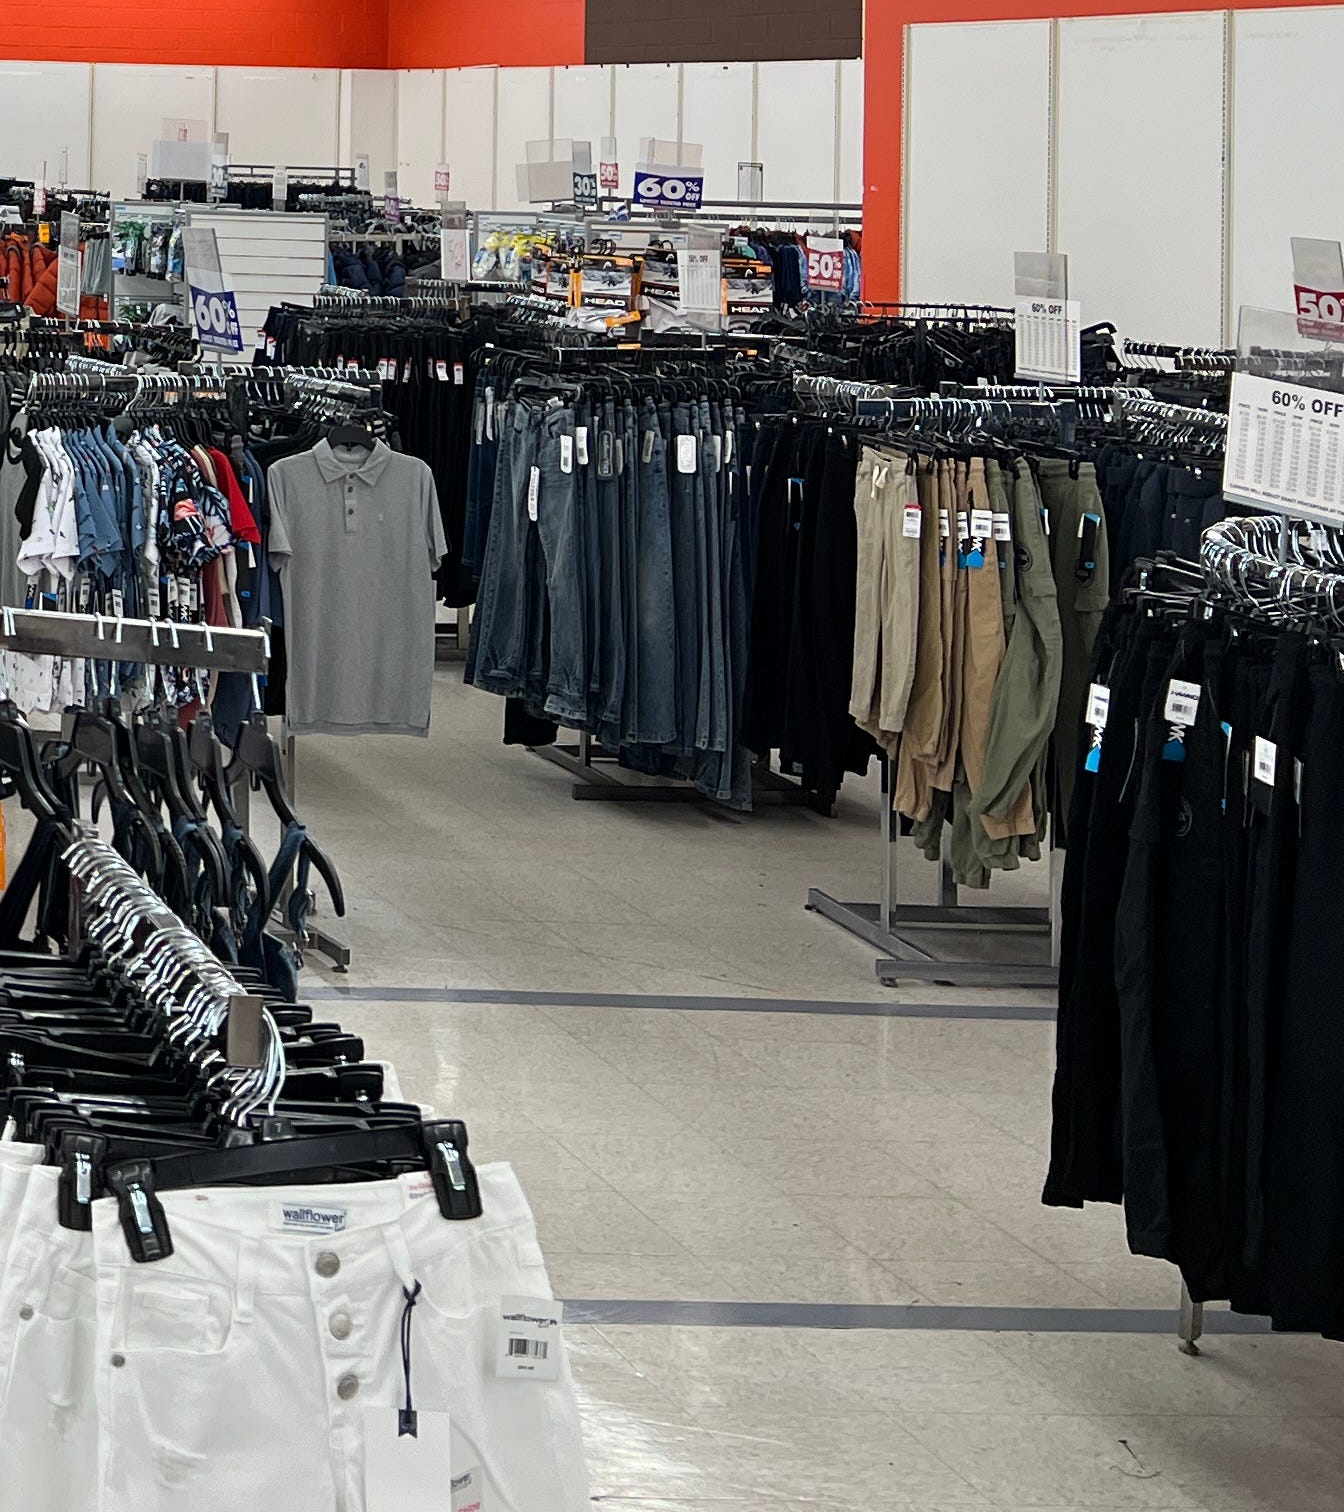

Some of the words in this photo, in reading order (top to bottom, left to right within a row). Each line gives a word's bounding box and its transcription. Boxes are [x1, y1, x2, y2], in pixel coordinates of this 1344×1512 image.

[637, 177, 700, 200] 60%
[685, 192, 700, 201] OFF
[808, 252, 842, 279] 50%
[584, 297, 626, 307] HEAD
[644, 287, 681, 297] HEA
[195, 294, 236, 334] 60%
[731, 306, 770, 314] HEAD
[1298, 291, 1344, 323] 50
[1271, 390, 1306, 411] 60%
[1312, 399, 1344, 418] OFF
[282, 1208, 345, 1225] wallflower
